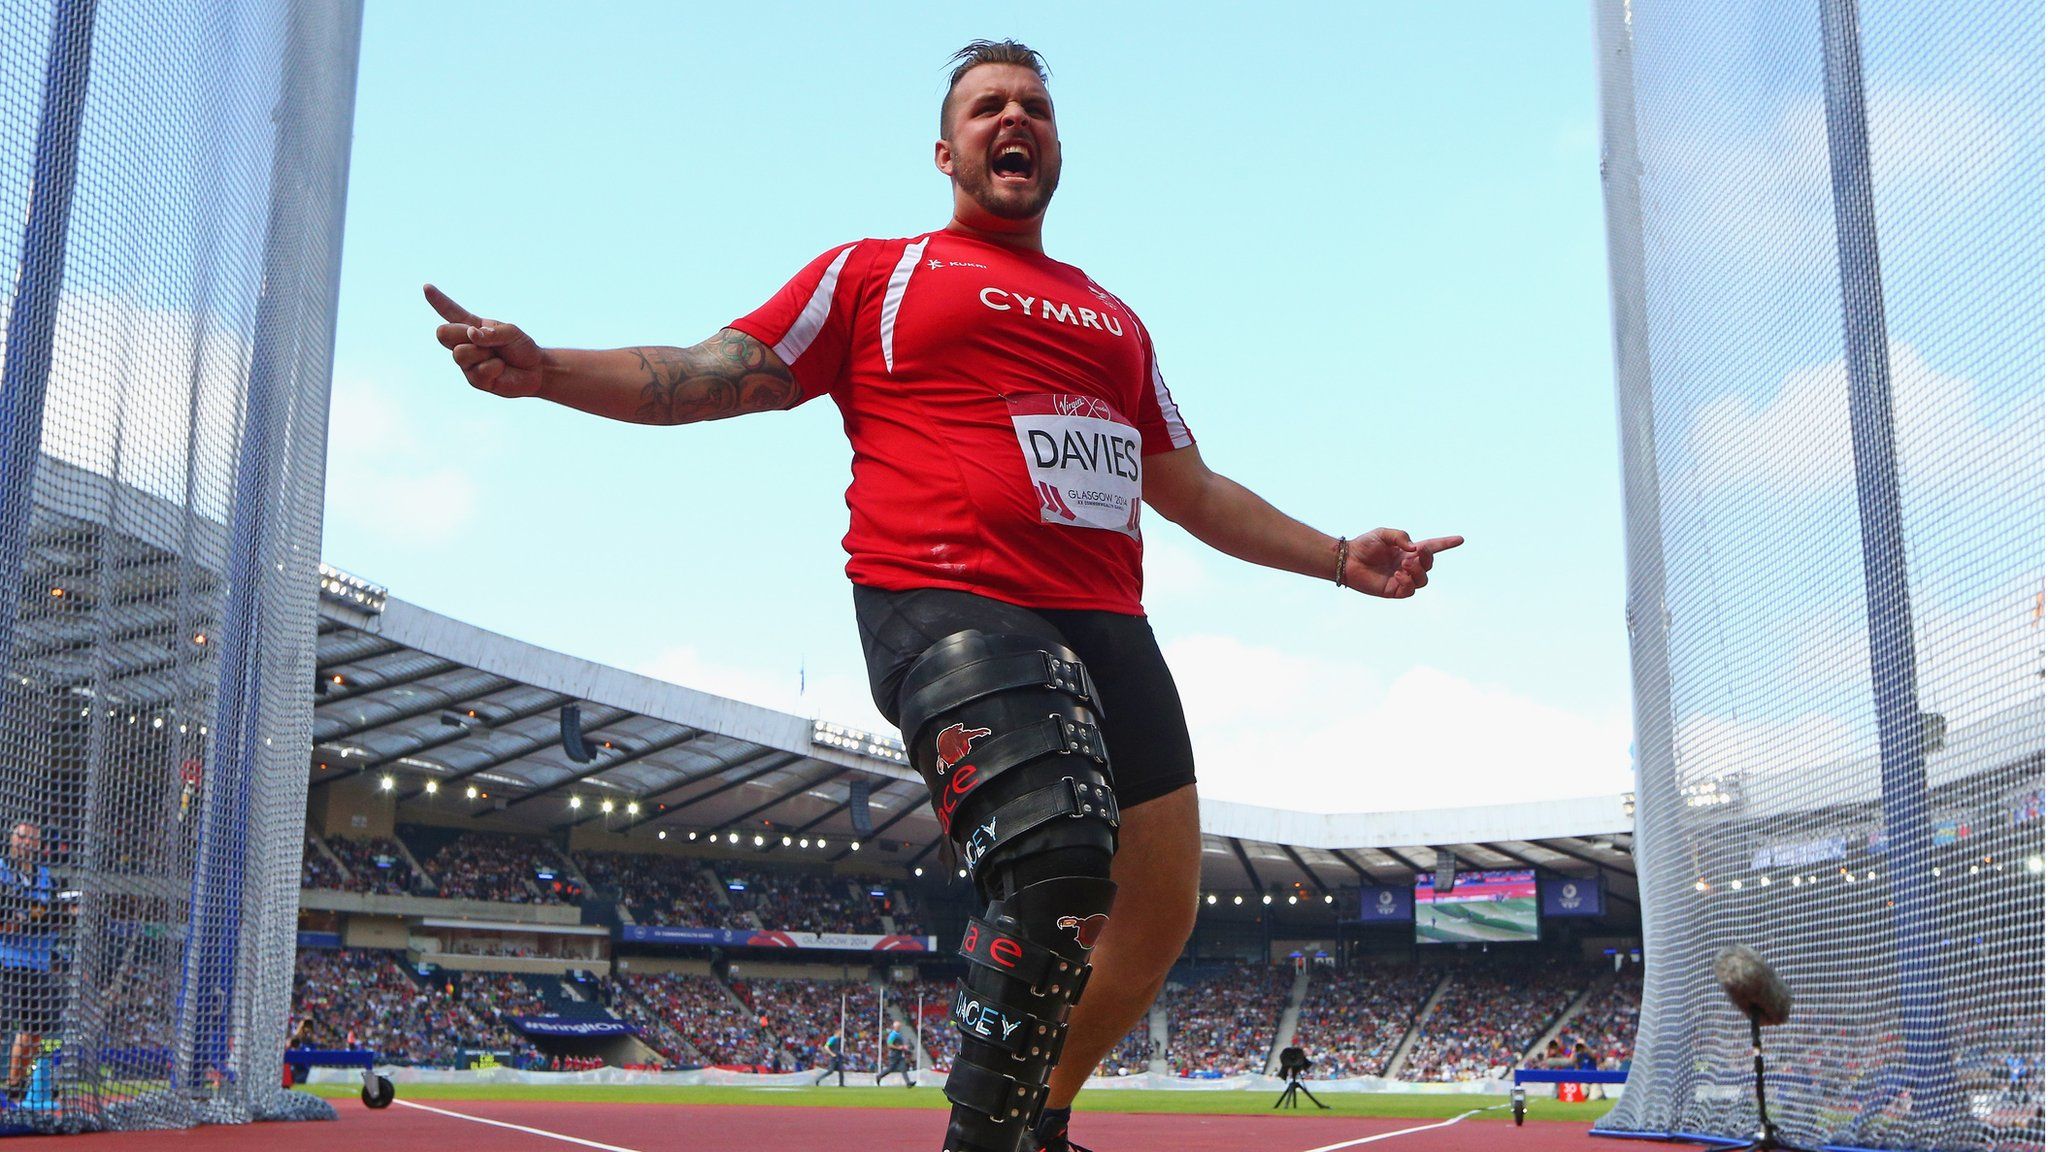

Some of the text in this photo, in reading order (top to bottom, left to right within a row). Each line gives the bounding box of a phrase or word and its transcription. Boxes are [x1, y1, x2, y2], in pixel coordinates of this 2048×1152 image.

[949, 261, 987, 269] KUKRI
[979, 287, 1123, 337] CYMRU
[1059, 396, 1086, 414] Virgin
[1027, 429, 1139, 482] DAVIES
[1067, 489, 1128, 506] GLASGOW 2014
[802, 936, 847, 945] GLASGOW
